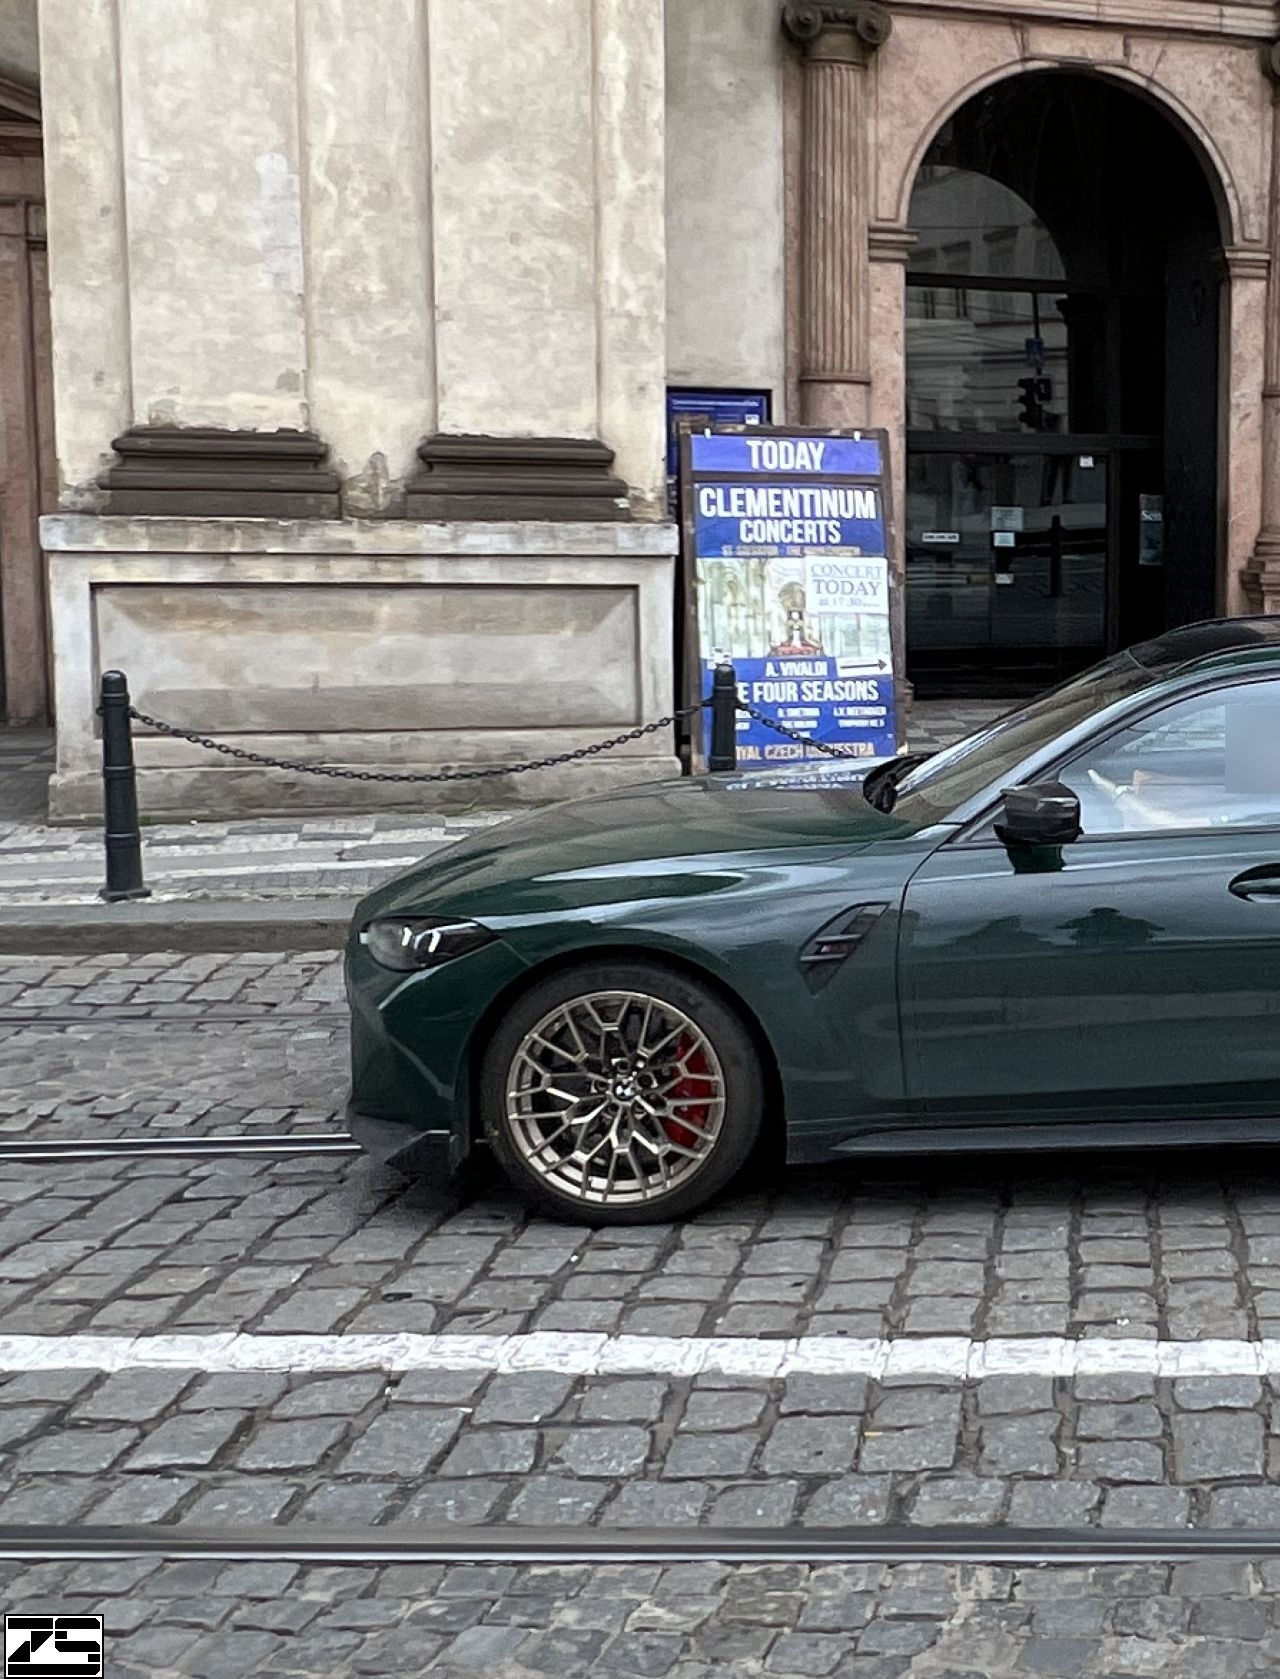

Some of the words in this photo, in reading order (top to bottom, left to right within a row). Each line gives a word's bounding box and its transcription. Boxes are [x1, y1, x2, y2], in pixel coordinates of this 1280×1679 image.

[746, 440, 825, 471] TODAY
[699, 487, 877, 519] CLEMENTINUM
[739, 519, 841, 544] CONCERTS
[810, 563, 883, 579] CONCERT
[812, 578, 882, 596] TODAY
[780, 660, 828, 677] VIVALDI
[753, 681, 799, 703] FOUR
[802, 679, 880, 702] SEASONS
